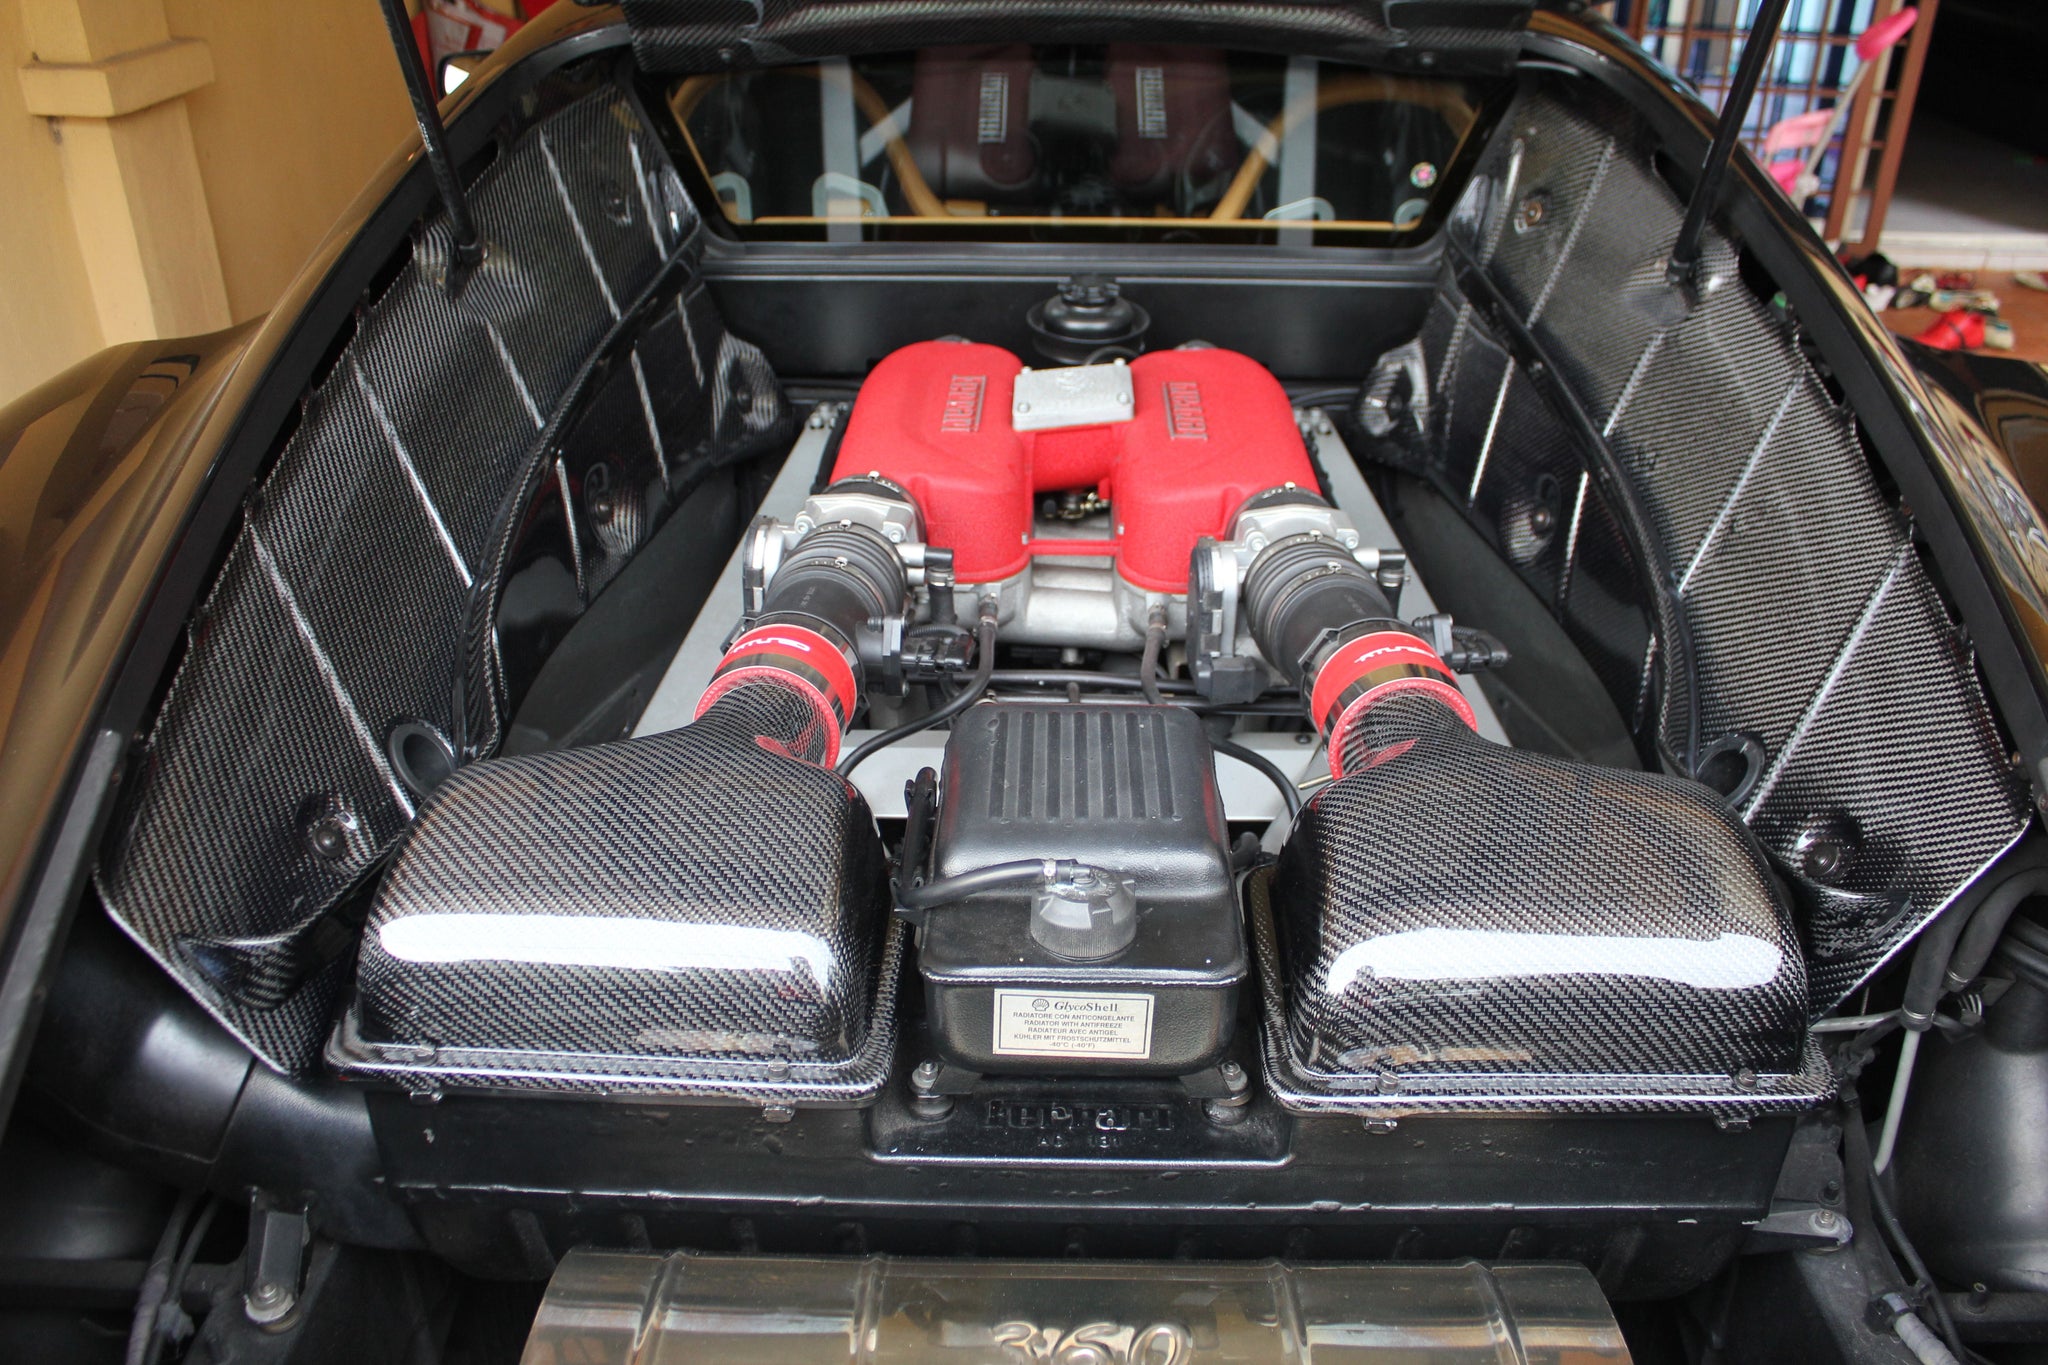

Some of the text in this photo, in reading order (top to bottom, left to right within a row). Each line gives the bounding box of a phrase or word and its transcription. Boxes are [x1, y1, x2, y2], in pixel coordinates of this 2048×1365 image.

[1054, 1001, 1118, 1013] GlycoShell
[1071, 1014, 1135, 1022] ANTICONGELANTE
[1080, 1021, 1123, 1029] ANTIFREEZE
[1057, 1035, 1131, 1044] FROSTSCHUTZMITTEL
